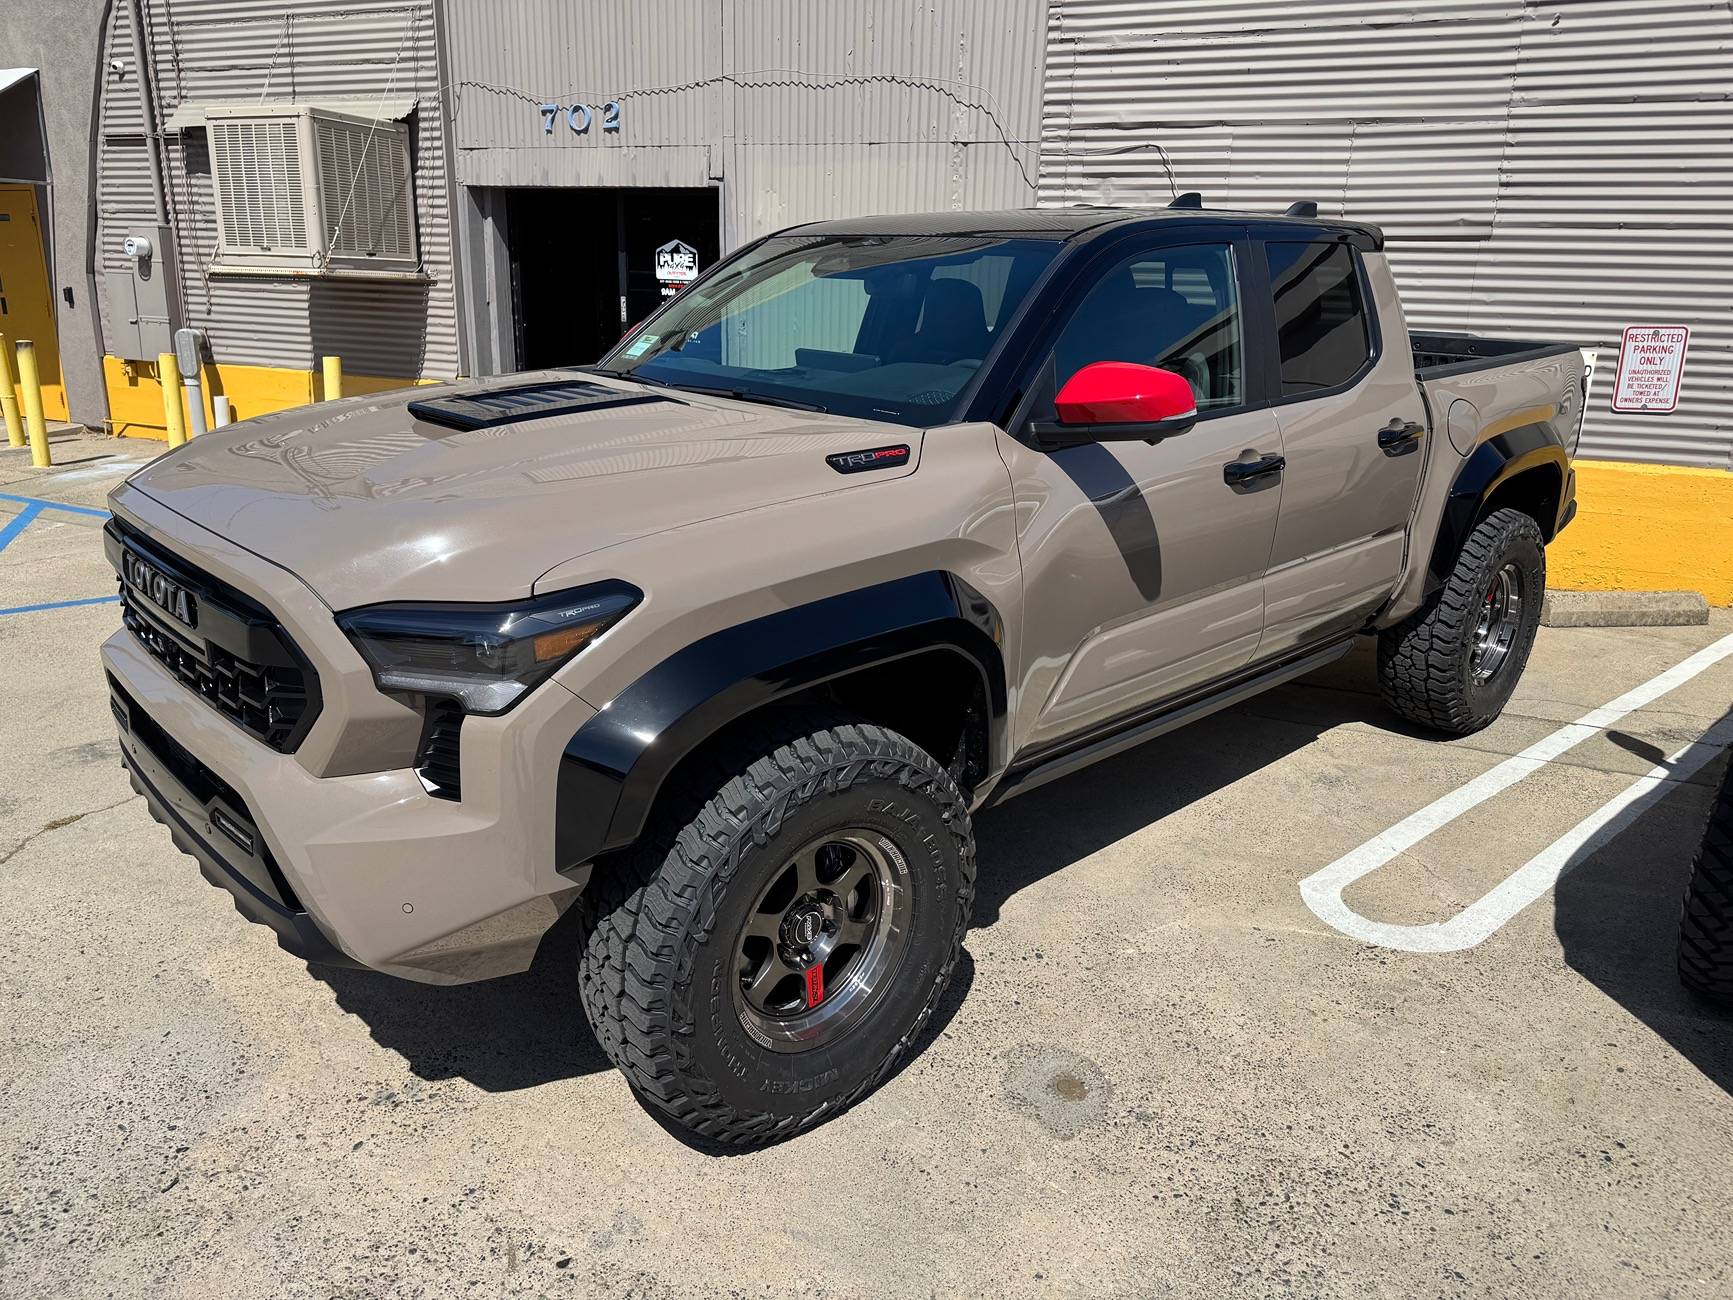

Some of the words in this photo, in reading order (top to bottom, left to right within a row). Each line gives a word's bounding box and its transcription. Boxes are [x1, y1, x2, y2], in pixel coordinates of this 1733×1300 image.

[540, 101, 620, 132] 702
[660, 253, 694, 267] PURE
[1628, 333, 1683, 343] RESTRICTED
[1633, 345, 1674, 354] PARKING
[1639, 356, 1665, 366] ONLY
[127, 553, 190, 624] TOYOTA
